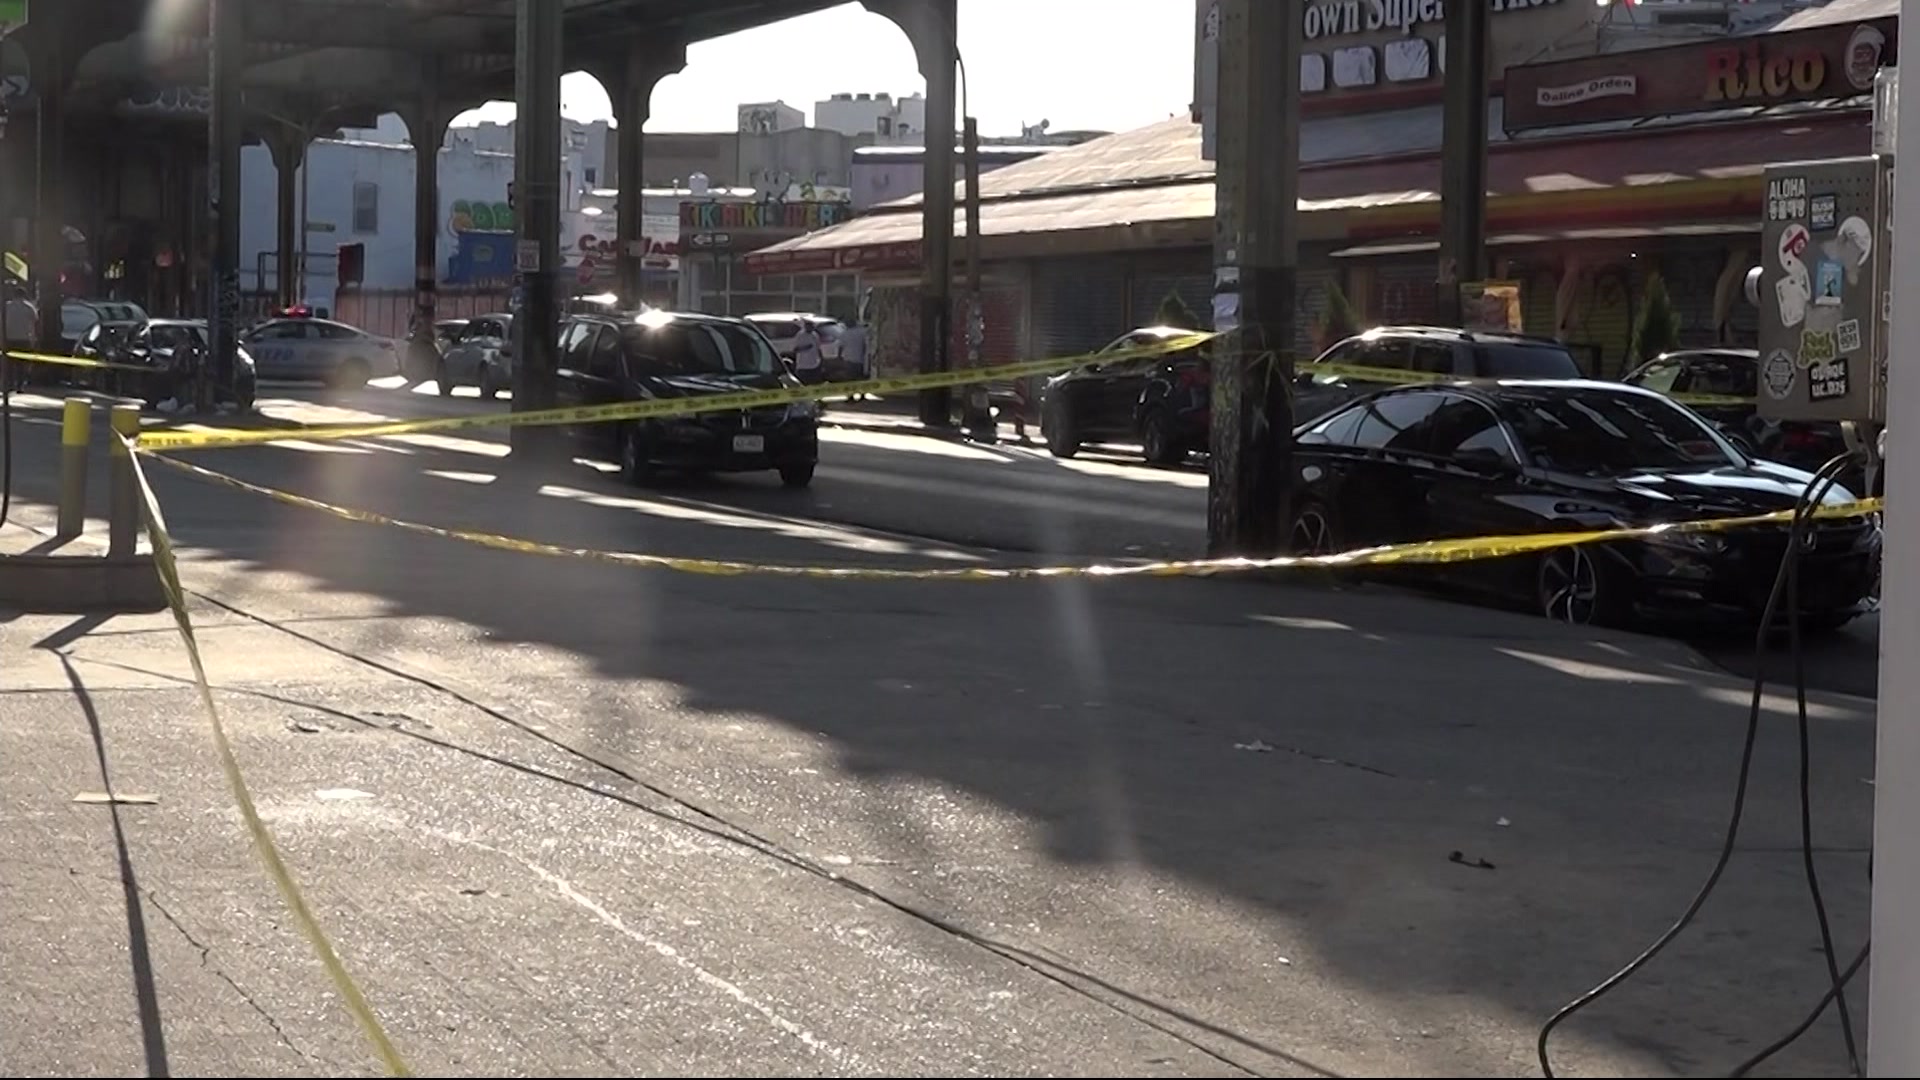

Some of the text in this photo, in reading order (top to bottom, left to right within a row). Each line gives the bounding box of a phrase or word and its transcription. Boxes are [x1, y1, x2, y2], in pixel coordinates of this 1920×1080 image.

[1303, 1, 1361, 39] own
[1703, 44, 1826, 101] Rico
[1769, 178, 1806, 200] ALOHA
